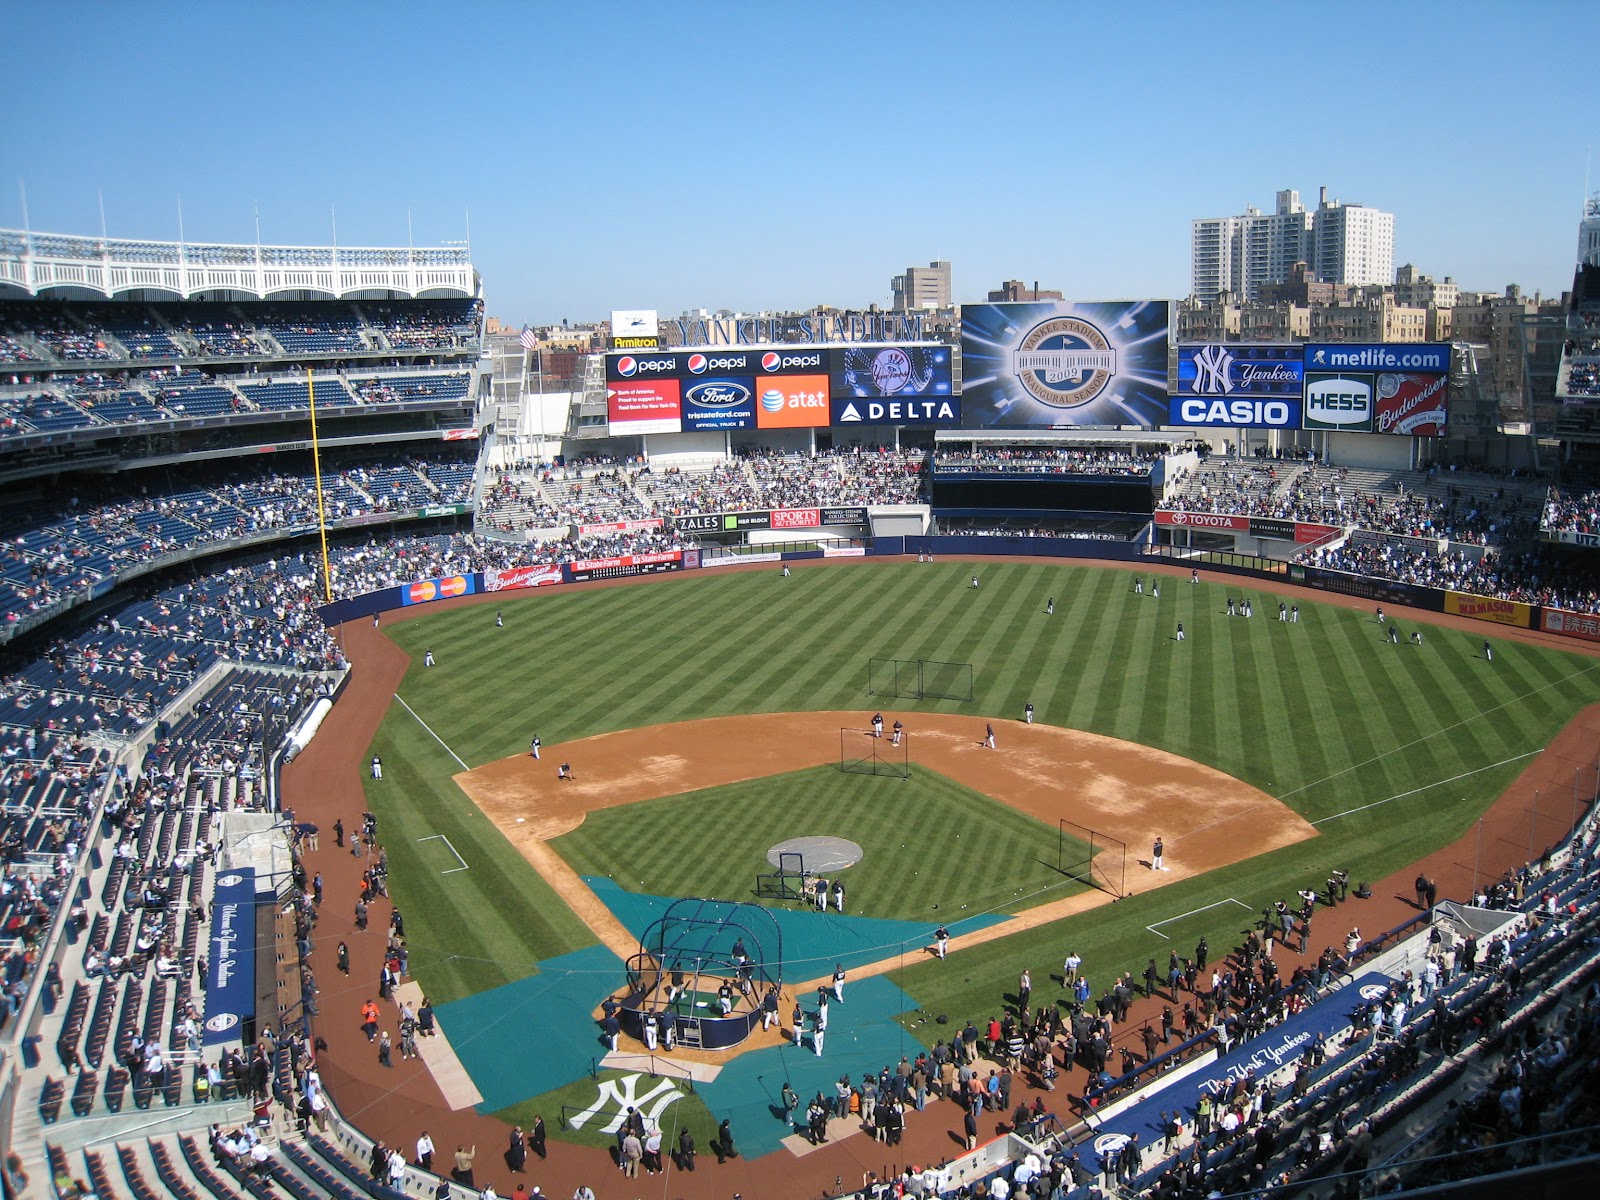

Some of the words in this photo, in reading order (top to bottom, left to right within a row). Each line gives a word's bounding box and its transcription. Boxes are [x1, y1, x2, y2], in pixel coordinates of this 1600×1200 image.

[674, 317, 783, 347] YANKEE
[800, 315, 923, 343] STADIUM
[1025, 322, 1059, 350] YANKEE
[1062, 322, 1103, 349] STADIUM
[614, 337, 657, 348] Armitron
[638, 358, 676, 373] pepsi
[708, 356, 746, 371] pepsi
[782, 354, 820, 369] pepsi
[1331, 348, 1440, 368] metlife.com
[1050, 368, 1078, 382] 2009
[1240, 363, 1299, 388] Yankees
[701, 387, 736, 403] Ford
[1024, 372, 1072, 404] INAUGURAL
[1074, 373, 1106, 402] SEASON
[788, 391, 825, 408] at&t
[1310, 393, 1367, 411] HESS
[1375, 375, 1448, 433] Budweiser
[687, 411, 751, 419] tristateford.com
[869, 402, 954, 419] DELTA
[1181, 400, 1289, 425] CASIO
[1402, 416, 1427, 430] American
[680, 516, 718, 530] ZALES
[774, 510, 817, 521] SPORTS
[1188, 514, 1232, 528] TOYOTA
[586, 561, 603, 569] State
[640, 555, 658, 563] State
[493, 565, 552, 591] Budweiser
[410, 588, 436, 597] MasterCard
[440, 582, 466, 592] MasterCard
[1564, 616, 1600, 637] 読売
[217, 959, 236, 988] Stadium
[1226, 1054, 1266, 1080] York
[1256, 1031, 1311, 1065] Yankees
